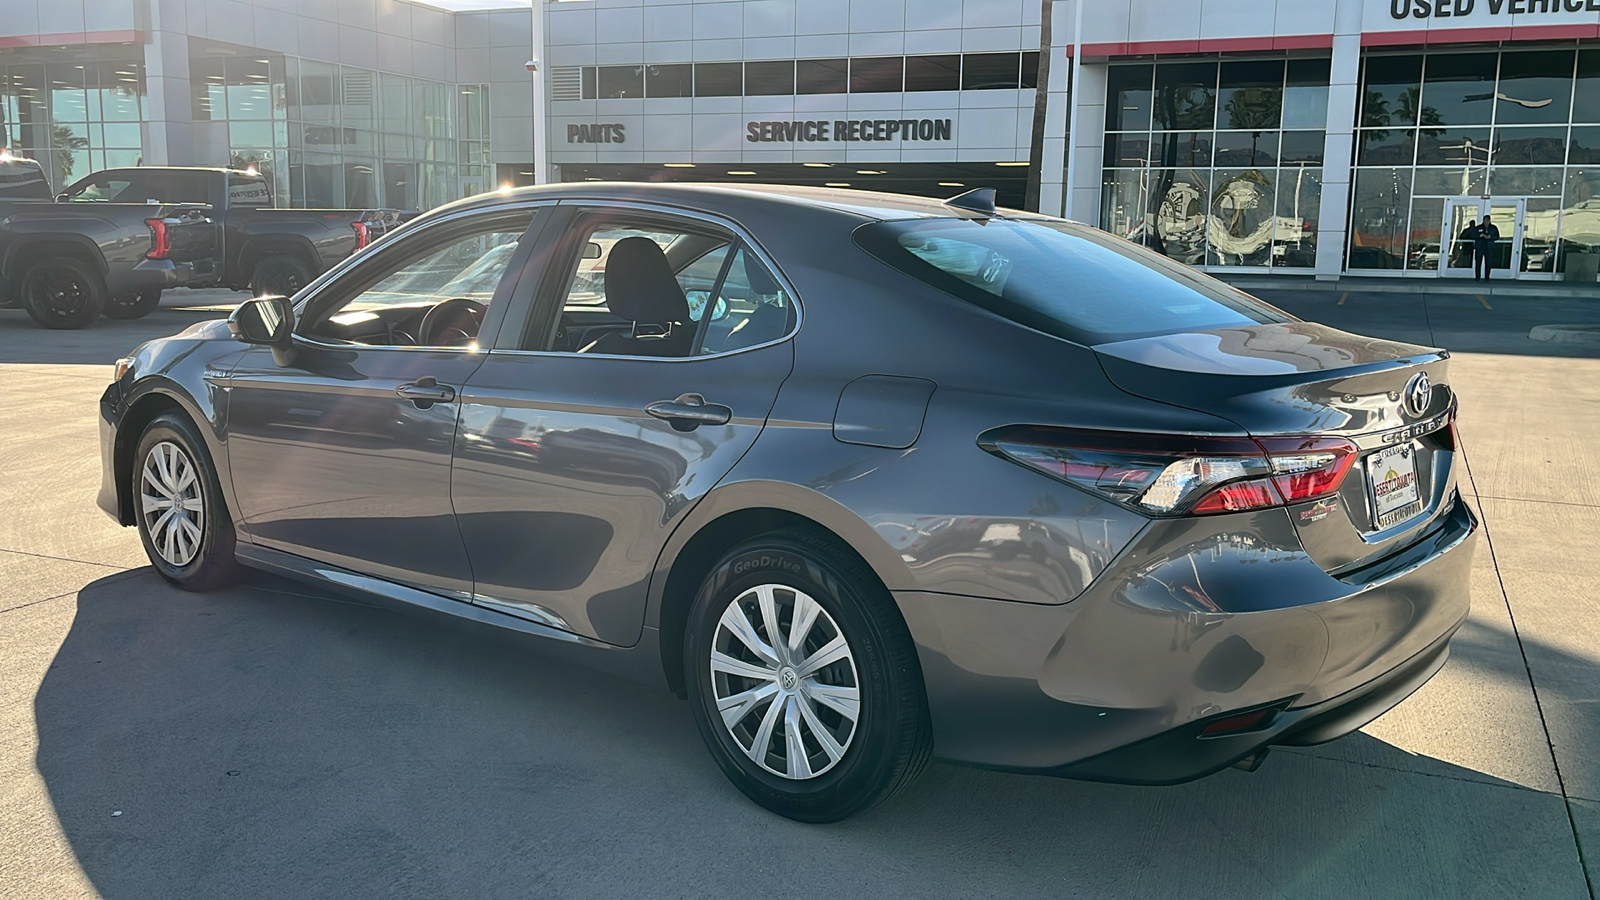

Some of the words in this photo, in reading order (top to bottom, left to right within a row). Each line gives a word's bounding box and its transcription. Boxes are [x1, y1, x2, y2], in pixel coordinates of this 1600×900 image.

[1390, 0, 1475, 19] USED
[567, 123, 626, 143] PARTS
[747, 121, 830, 142] SERVICE
[834, 119, 951, 141] RECEPTION
[734, 556, 801, 574] GeoDrive
